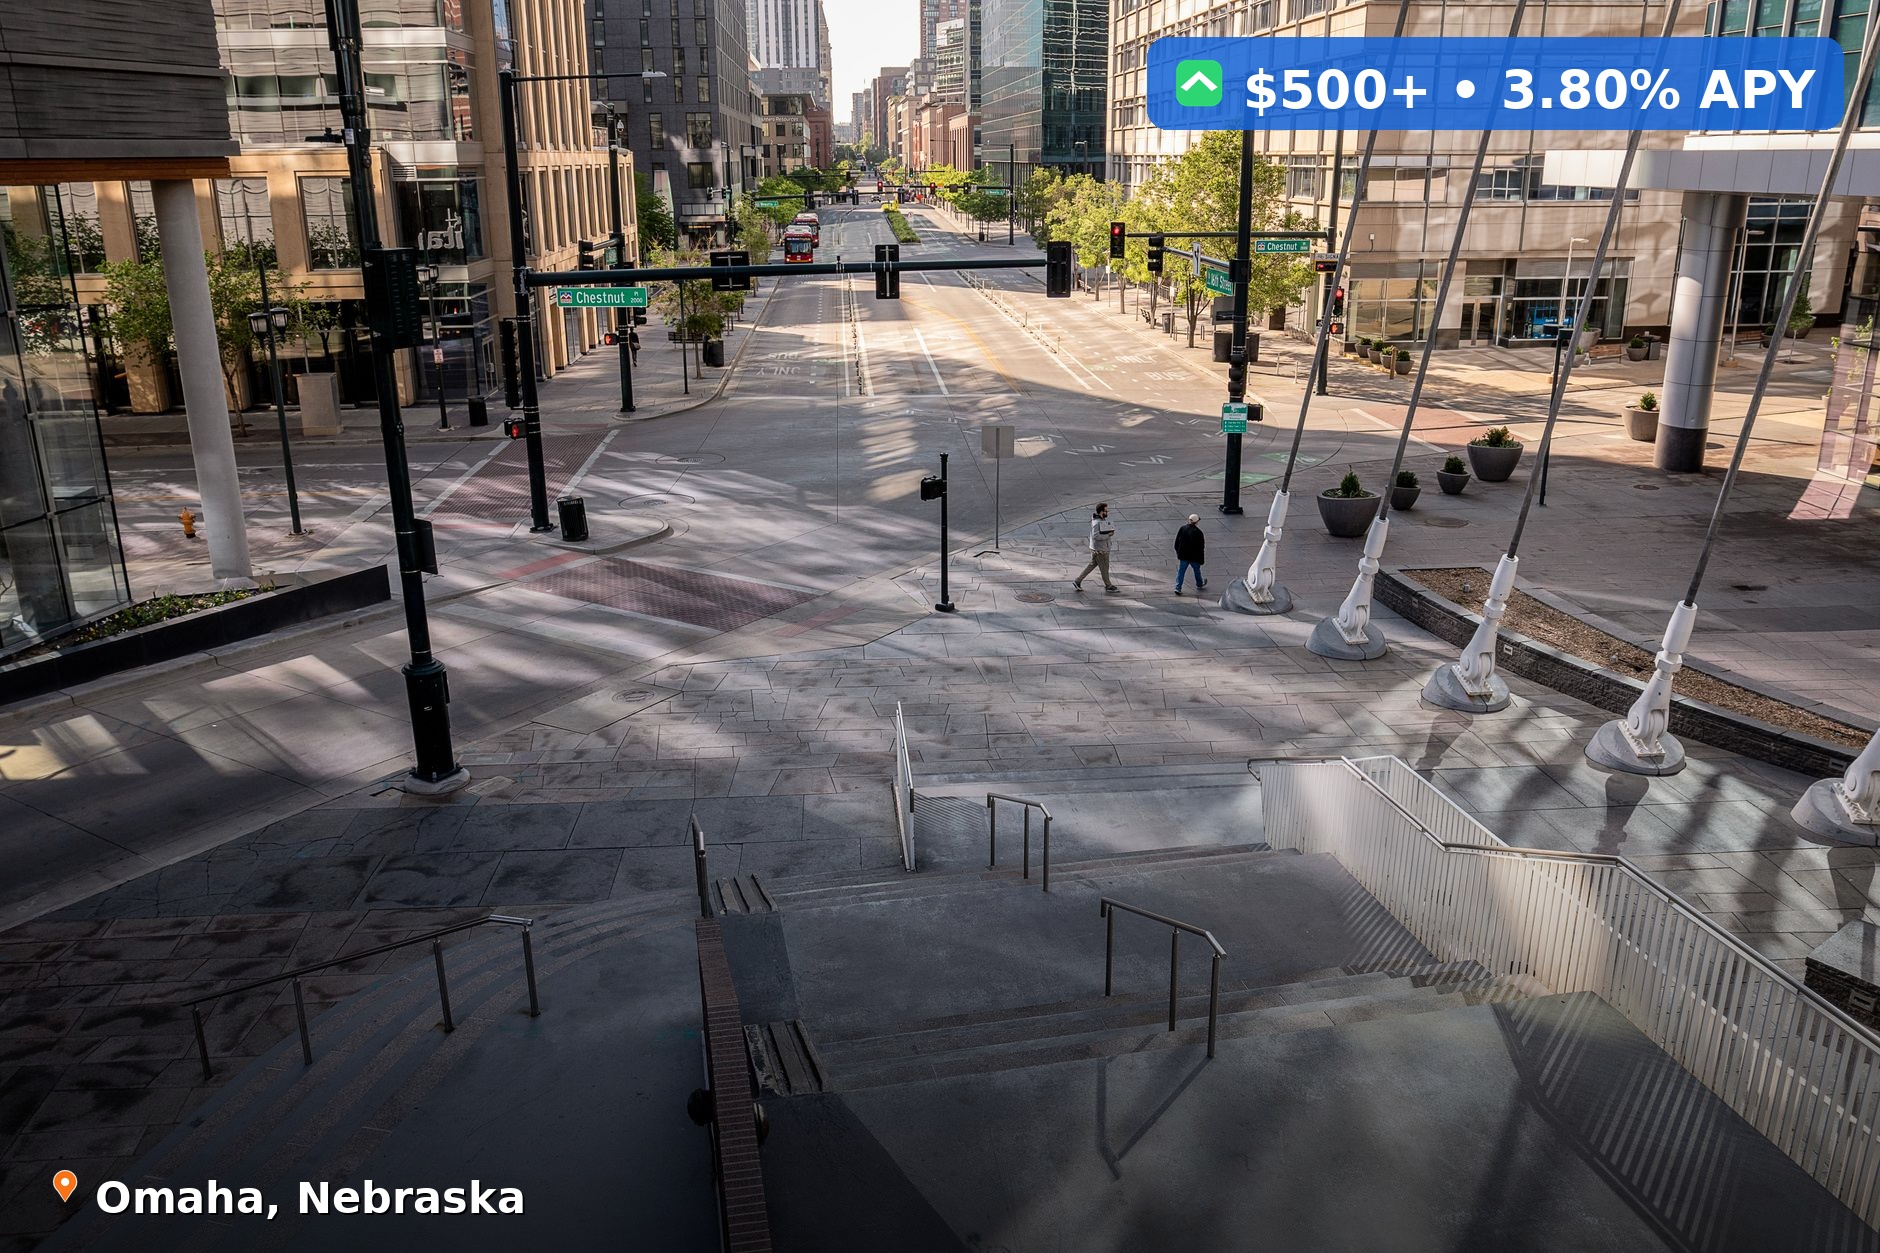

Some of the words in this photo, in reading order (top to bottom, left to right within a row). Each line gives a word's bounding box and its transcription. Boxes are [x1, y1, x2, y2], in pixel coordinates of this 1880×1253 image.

[1267, 242, 1298, 251] Chestnut
[1220, 275, 1232, 292] Street
[576, 291, 625, 304] Chestnut
